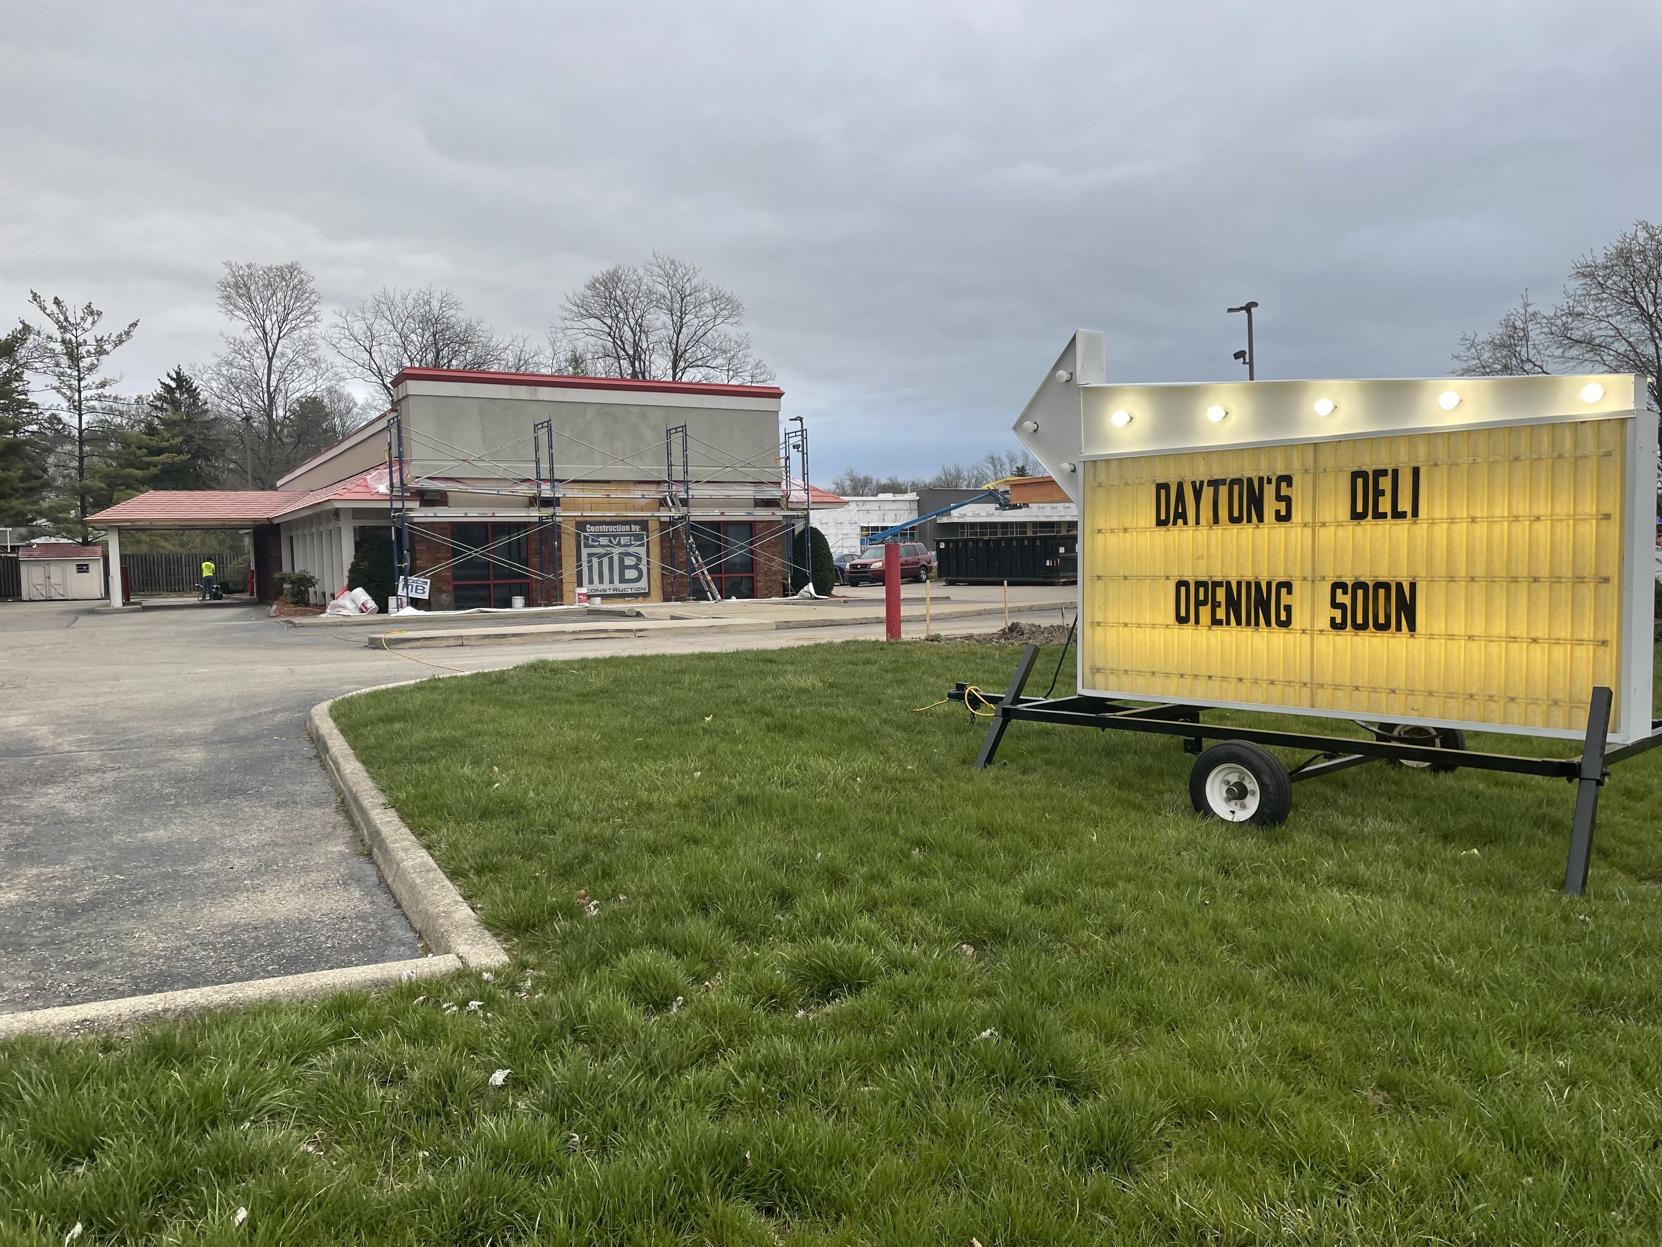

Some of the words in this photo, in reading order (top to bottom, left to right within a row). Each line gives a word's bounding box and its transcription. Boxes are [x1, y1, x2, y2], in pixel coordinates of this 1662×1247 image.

[1155, 474, 1293, 527] DAYTON'S
[1350, 466, 1420, 521] DELI
[586, 524, 630, 532] Construction
[588, 535, 640, 545] LEVEL
[1175, 580, 1293, 629] OPENING
[1329, 580, 1417, 633] SOON
